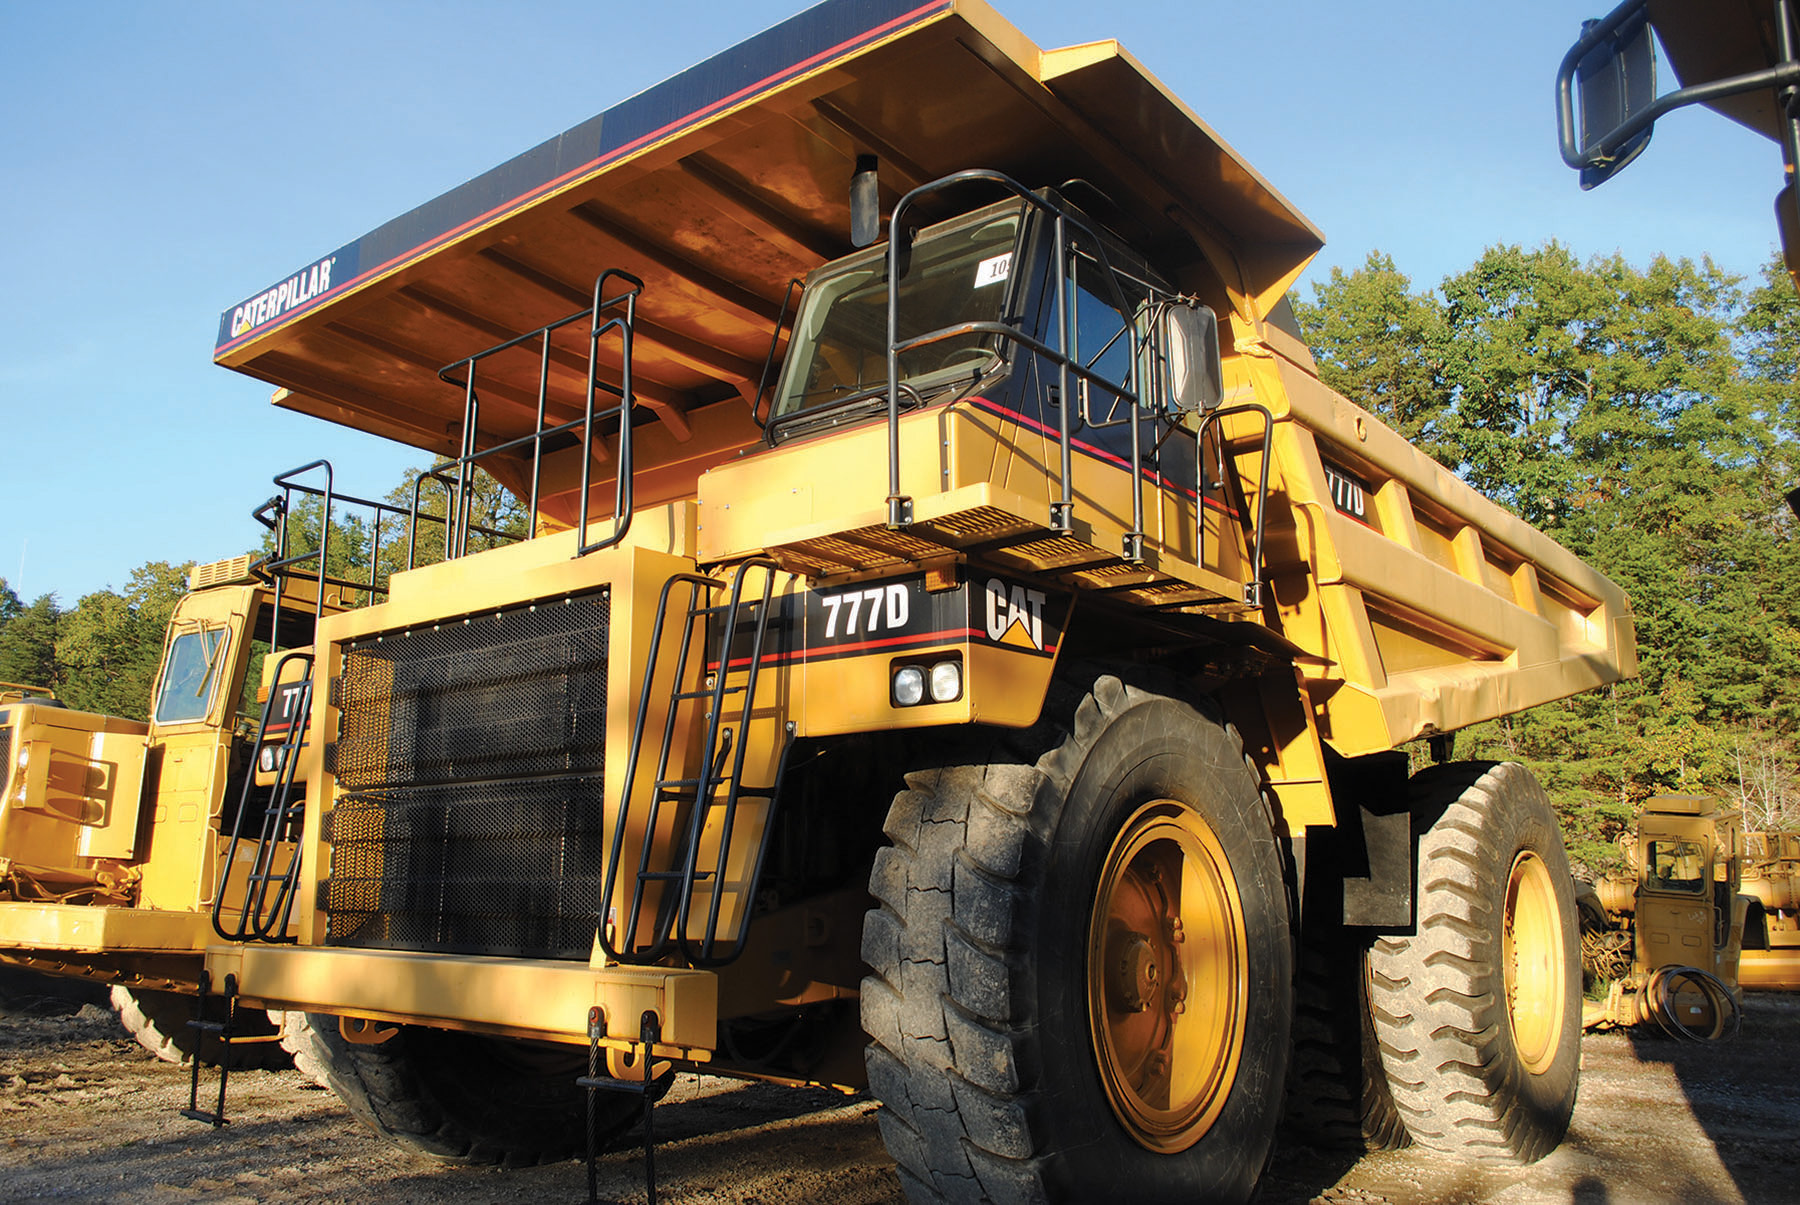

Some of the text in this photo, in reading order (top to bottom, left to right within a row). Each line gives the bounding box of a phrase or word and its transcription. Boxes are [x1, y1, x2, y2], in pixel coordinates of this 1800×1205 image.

[230, 258, 333, 338] CATERPILLAR
[1324, 464, 1364, 516] 777D
[822, 583, 909, 638] 777D
[985, 578, 1046, 650] CAT
